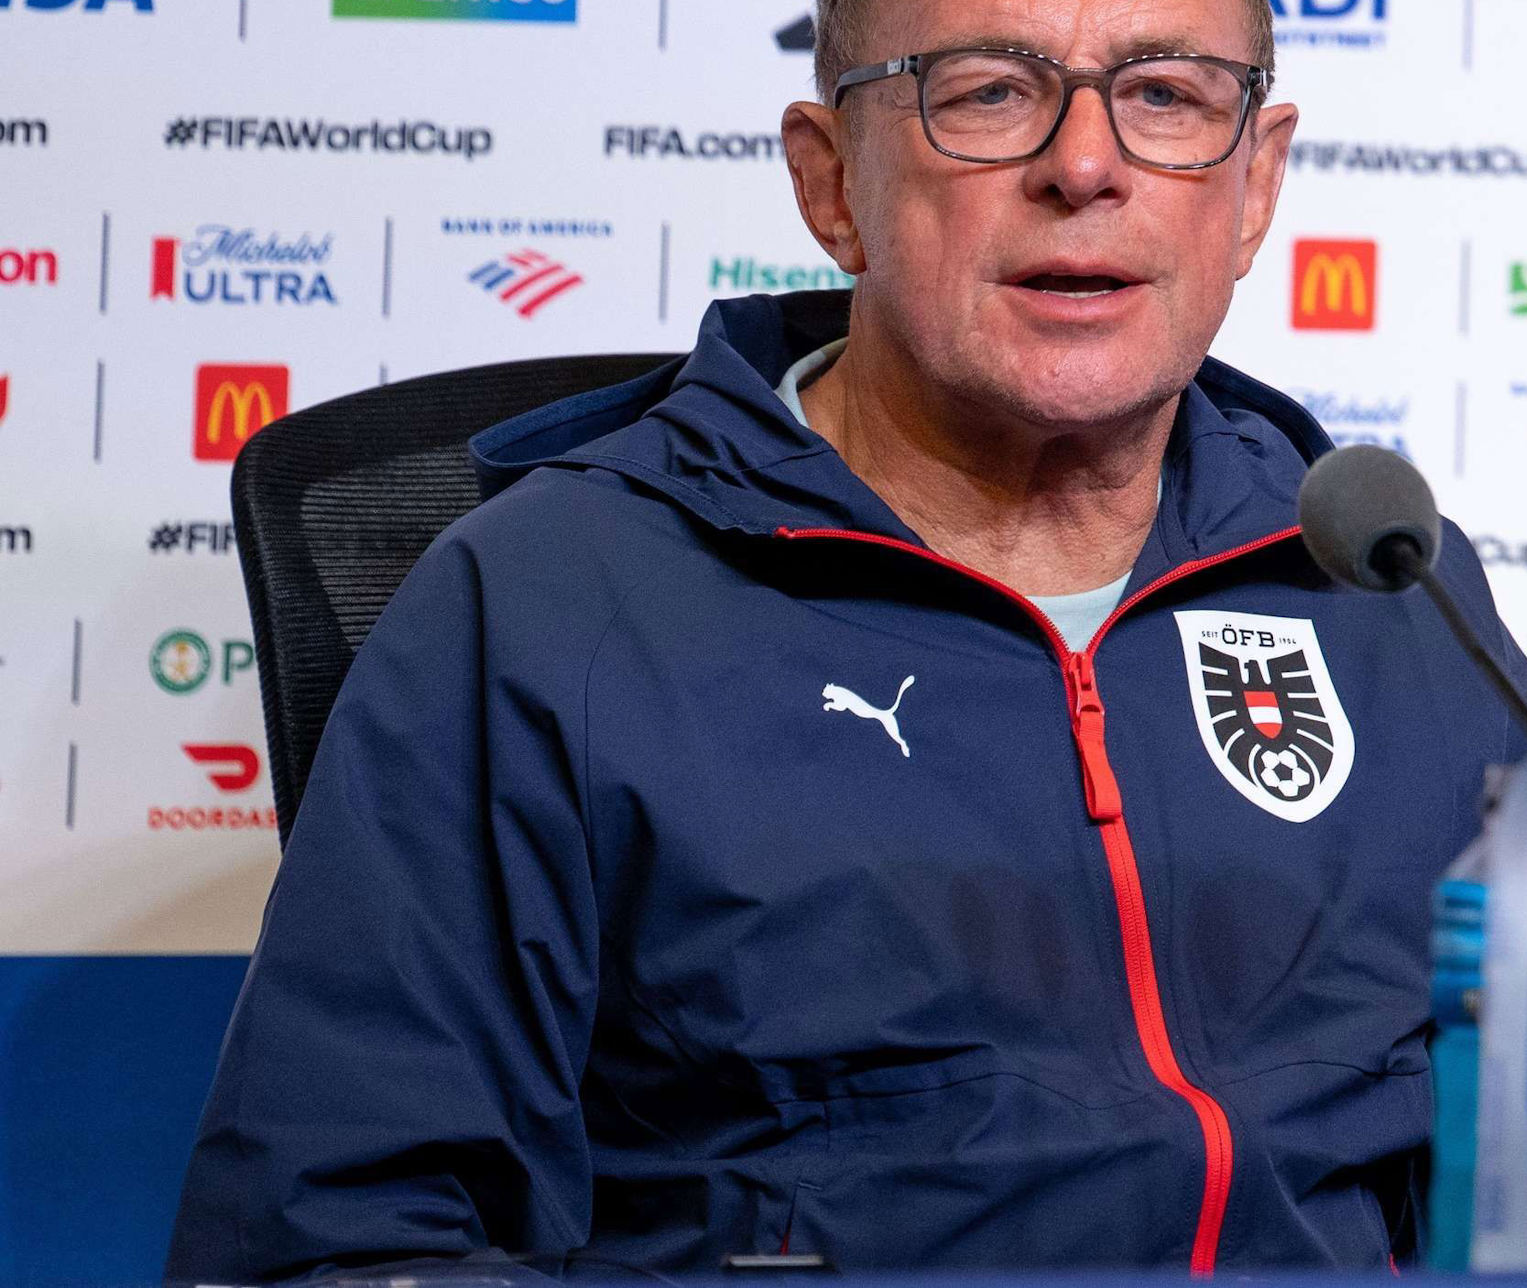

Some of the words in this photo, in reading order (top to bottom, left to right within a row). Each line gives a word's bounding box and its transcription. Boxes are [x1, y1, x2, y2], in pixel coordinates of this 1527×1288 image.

[164, 117, 493, 160] #FIFAWorldCup
[441, 215, 497, 234] BANK
[529, 217, 614, 238] AMERICA
[183, 271, 338, 306] ULTRA
[1220, 620, 1276, 649] ÖFB
